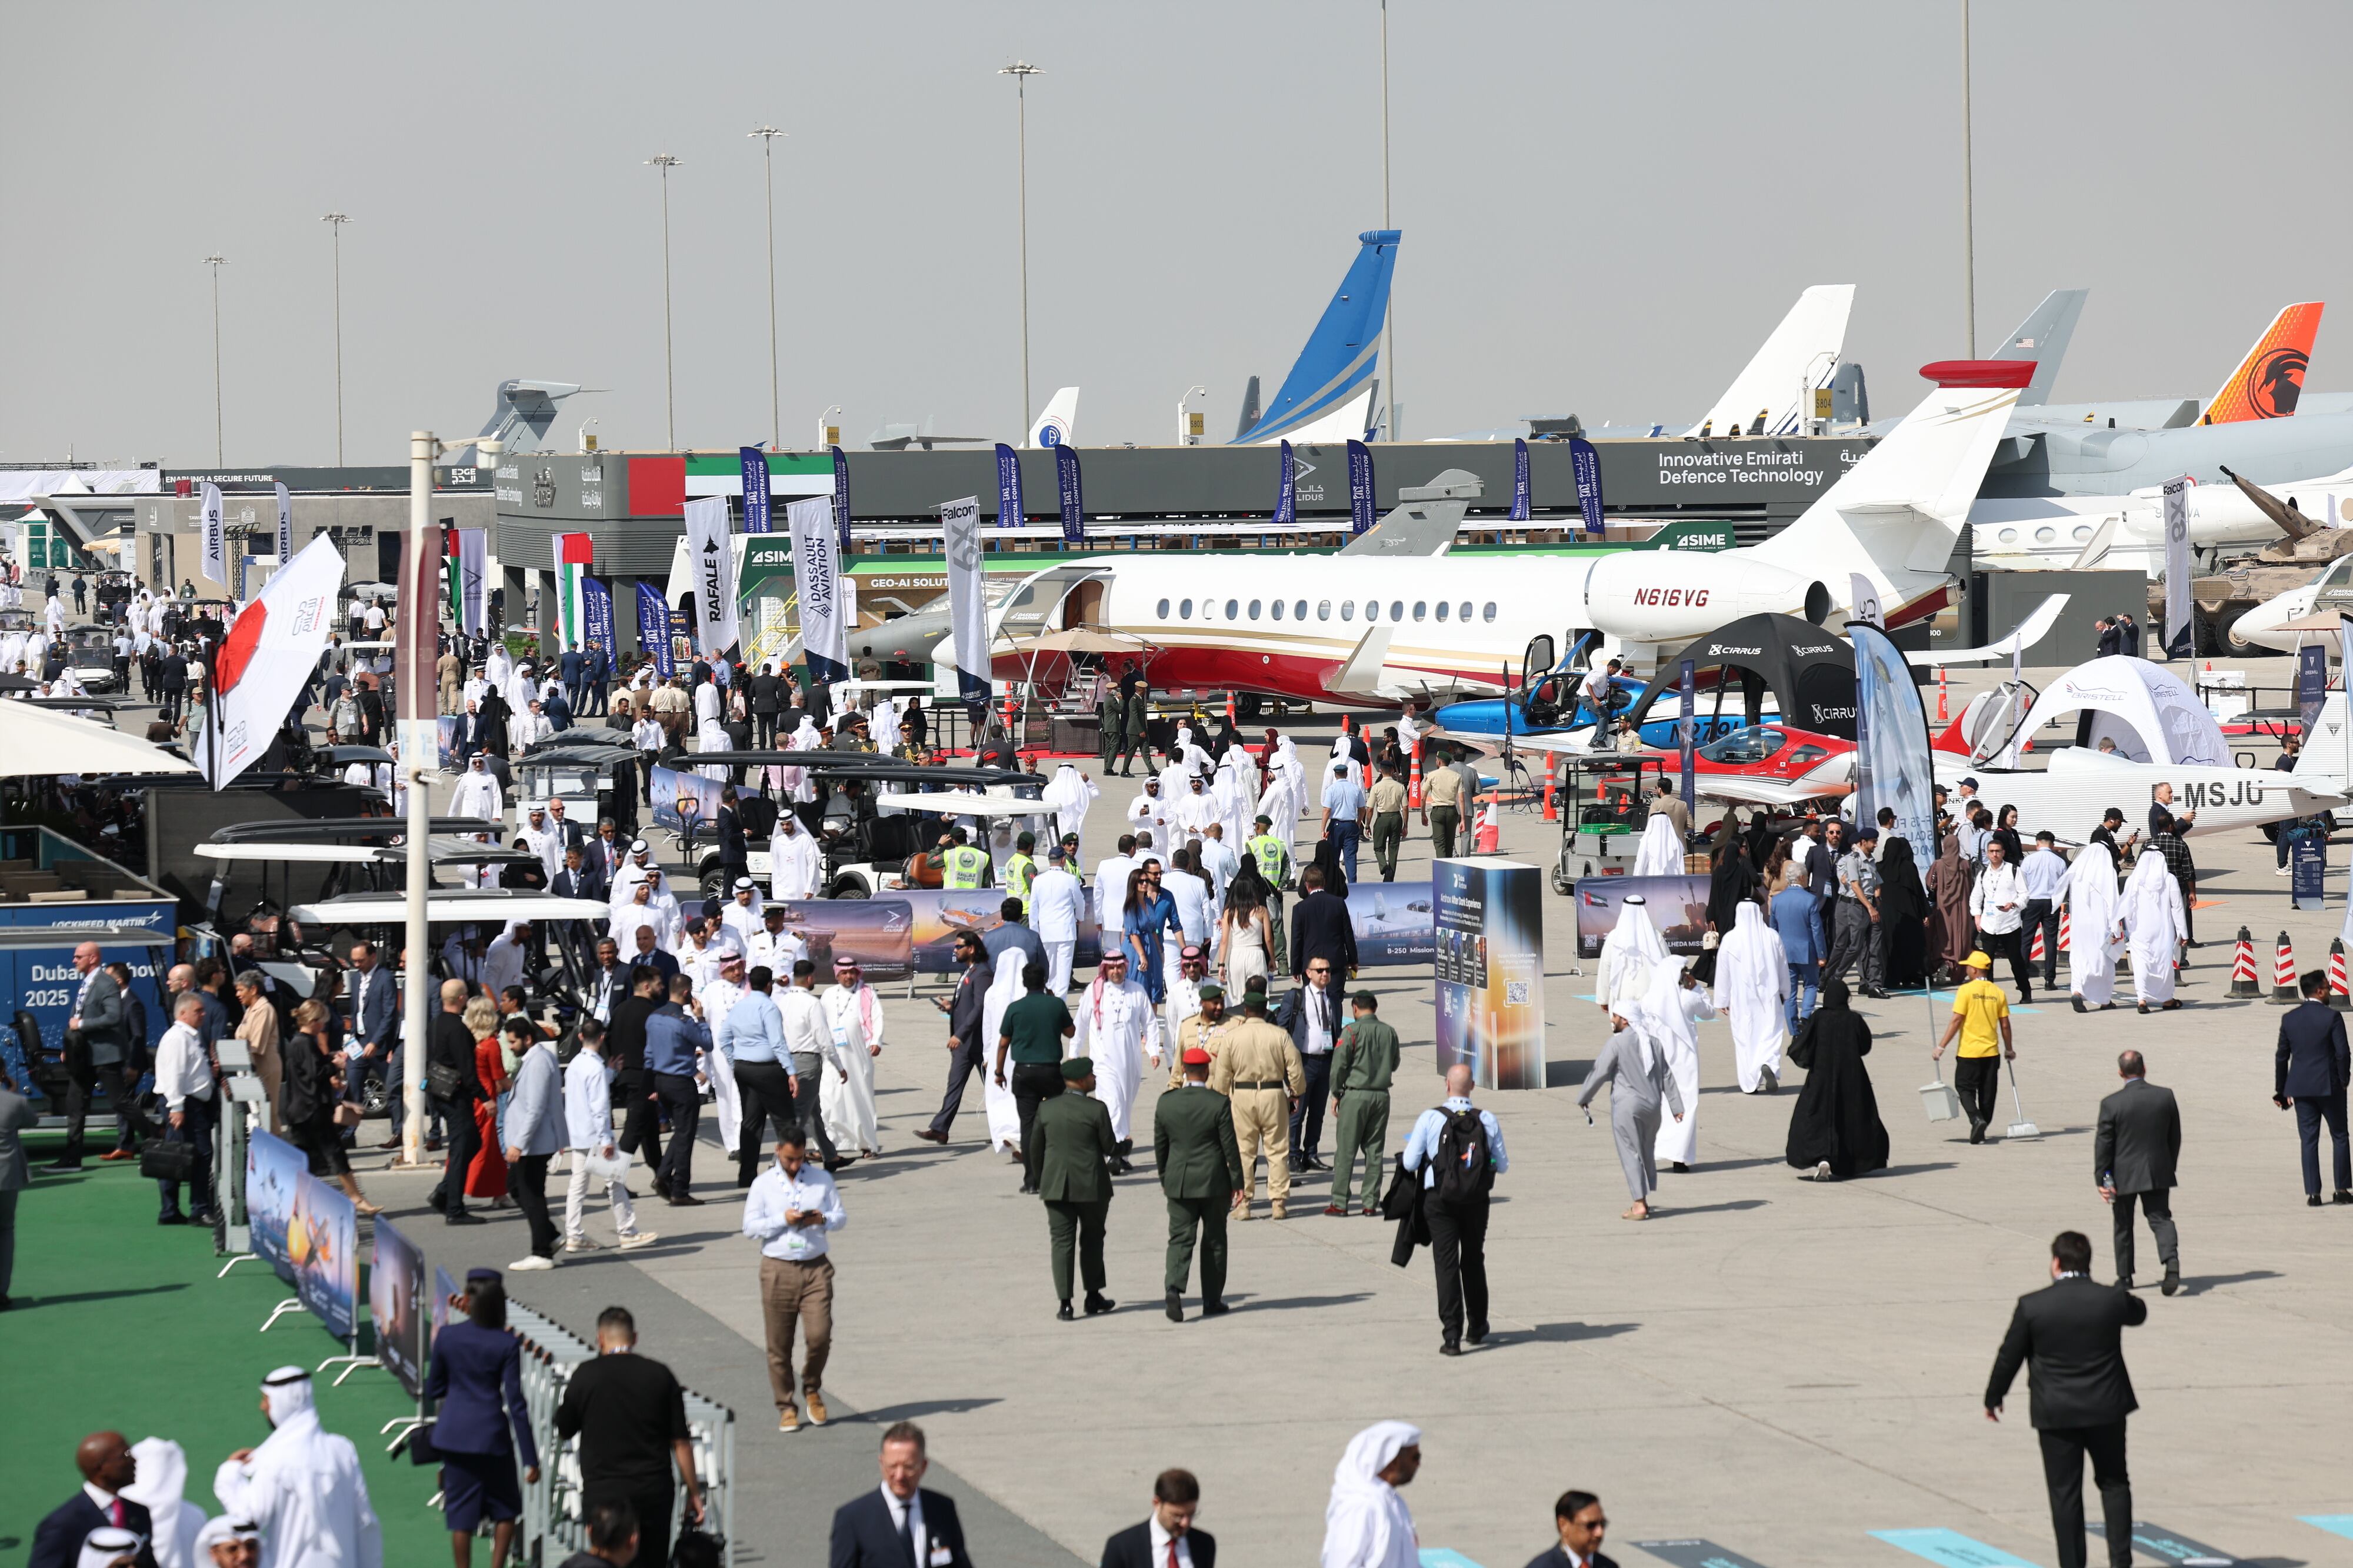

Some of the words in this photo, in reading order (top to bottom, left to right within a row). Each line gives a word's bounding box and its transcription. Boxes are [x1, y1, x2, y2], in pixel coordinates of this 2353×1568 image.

[1816, 398, 1831, 408] S804
[1659, 452, 1743, 467] Innovative
[1747, 451, 1803, 466] Emirati
[758, 461, 766, 506] CONTRACTOR
[1010, 458, 1018, 500] CONTRACTOR
[1071, 459, 1079, 505] CONTRACTOR
[1588, 452, 1597, 496] CONTRACTOR
[1659, 471, 1727, 484] Defence
[1729, 469, 1824, 486] Technology
[2164, 481, 2185, 496] Falcon
[942, 505, 975, 521] Falcon
[1064, 506, 1072, 535] AIRLINK
[1074, 505, 1082, 533] OFFICIAL
[1582, 498, 1591, 527] AIRLINK
[2171, 494, 2187, 543] 8X
[208, 509, 219, 561] AIRBUS
[280, 512, 288, 565] AIRBUS
[951, 518, 979, 572] 6X
[1689, 533, 1726, 546] SIME
[764, 551, 793, 563] SIM
[804, 534, 821, 602] DASSAULT
[816, 538, 831, 600] AVIATION
[704, 558, 721, 623] RAFALE
[871, 579, 911, 588] GEO-AI
[913, 578, 949, 587] SOLUT
[1634, 588, 1709, 607] N616VG
[600, 592, 609, 635] CONTRACTOR
[657, 598, 667, 643] CONTRACTOR
[660, 644, 669, 673] OFFICIAL
[1722, 646, 1762, 655] CIRRUS
[1801, 645, 1834, 655] CIRRUS
[2071, 692, 2125, 700] BRISTELL
[2151, 780, 2263, 808] -MSJU
[1441, 893, 1452, 903] Airshow
[1465, 898, 1482, 910] Experience
[106, 919, 146, 927] MARTIN
[25, 989, 70, 1007] 2025
